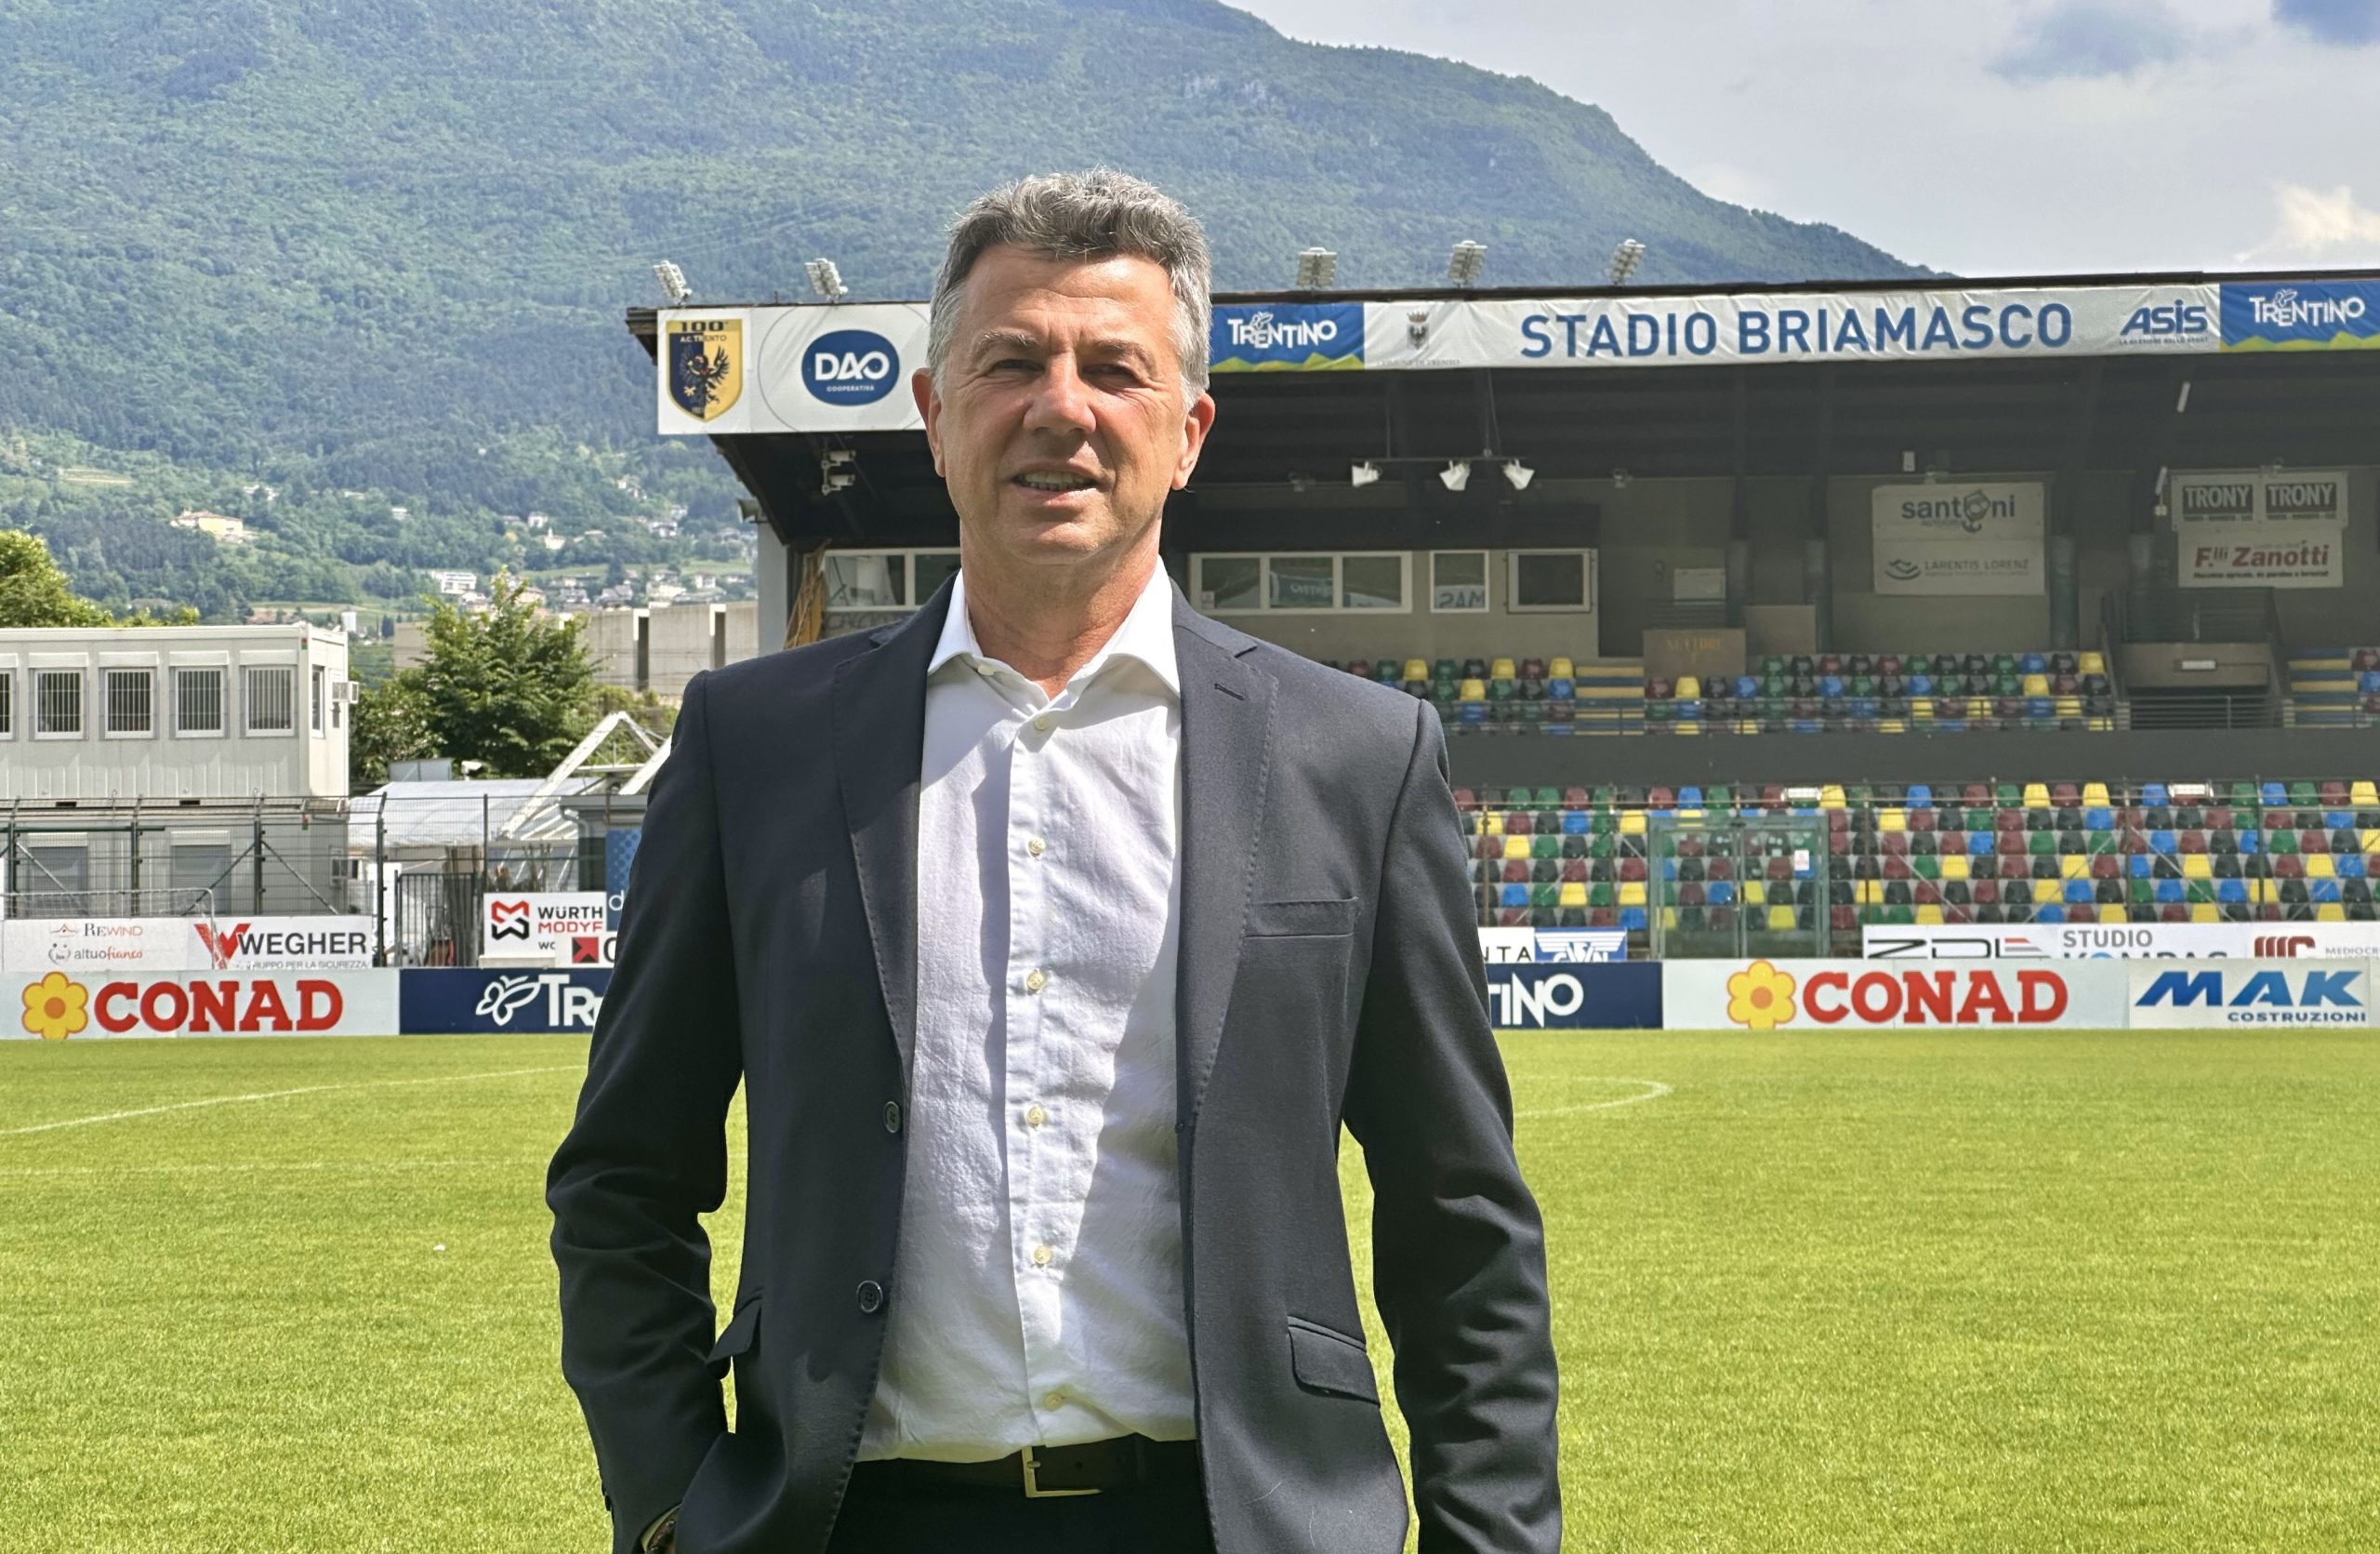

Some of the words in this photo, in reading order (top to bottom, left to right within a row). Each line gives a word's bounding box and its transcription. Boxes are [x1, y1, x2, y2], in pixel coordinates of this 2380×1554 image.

[2249, 294, 2366, 327] TRENTINO
[1226, 318, 1338, 350] TRENTINO
[1521, 310, 1718, 359] STADIO
[1739, 301, 2072, 354] BRIAMASCO
[814, 351, 891, 381] DAO
[826, 384, 875, 392] COOPERATIVA
[2185, 486, 2250, 509] TRONY
[2268, 484, 2334, 507] TRONY
[2232, 544, 2330, 568] Zanotti
[537, 921, 603, 934] MODYF
[2062, 929, 2153, 948] STUDIO
[238, 933, 367, 955] WEGHER
[285, 961, 303, 969] PER
[305, 961, 316, 969] LA
[318, 960, 367, 969] SICUREZZA
[1802, 970, 2069, 1025] CONAD
[2135, 970, 2364, 1007] MAK
[93, 979, 344, 1033] CONAD
[2228, 1011, 2366, 1023] COSTRUZIONI
